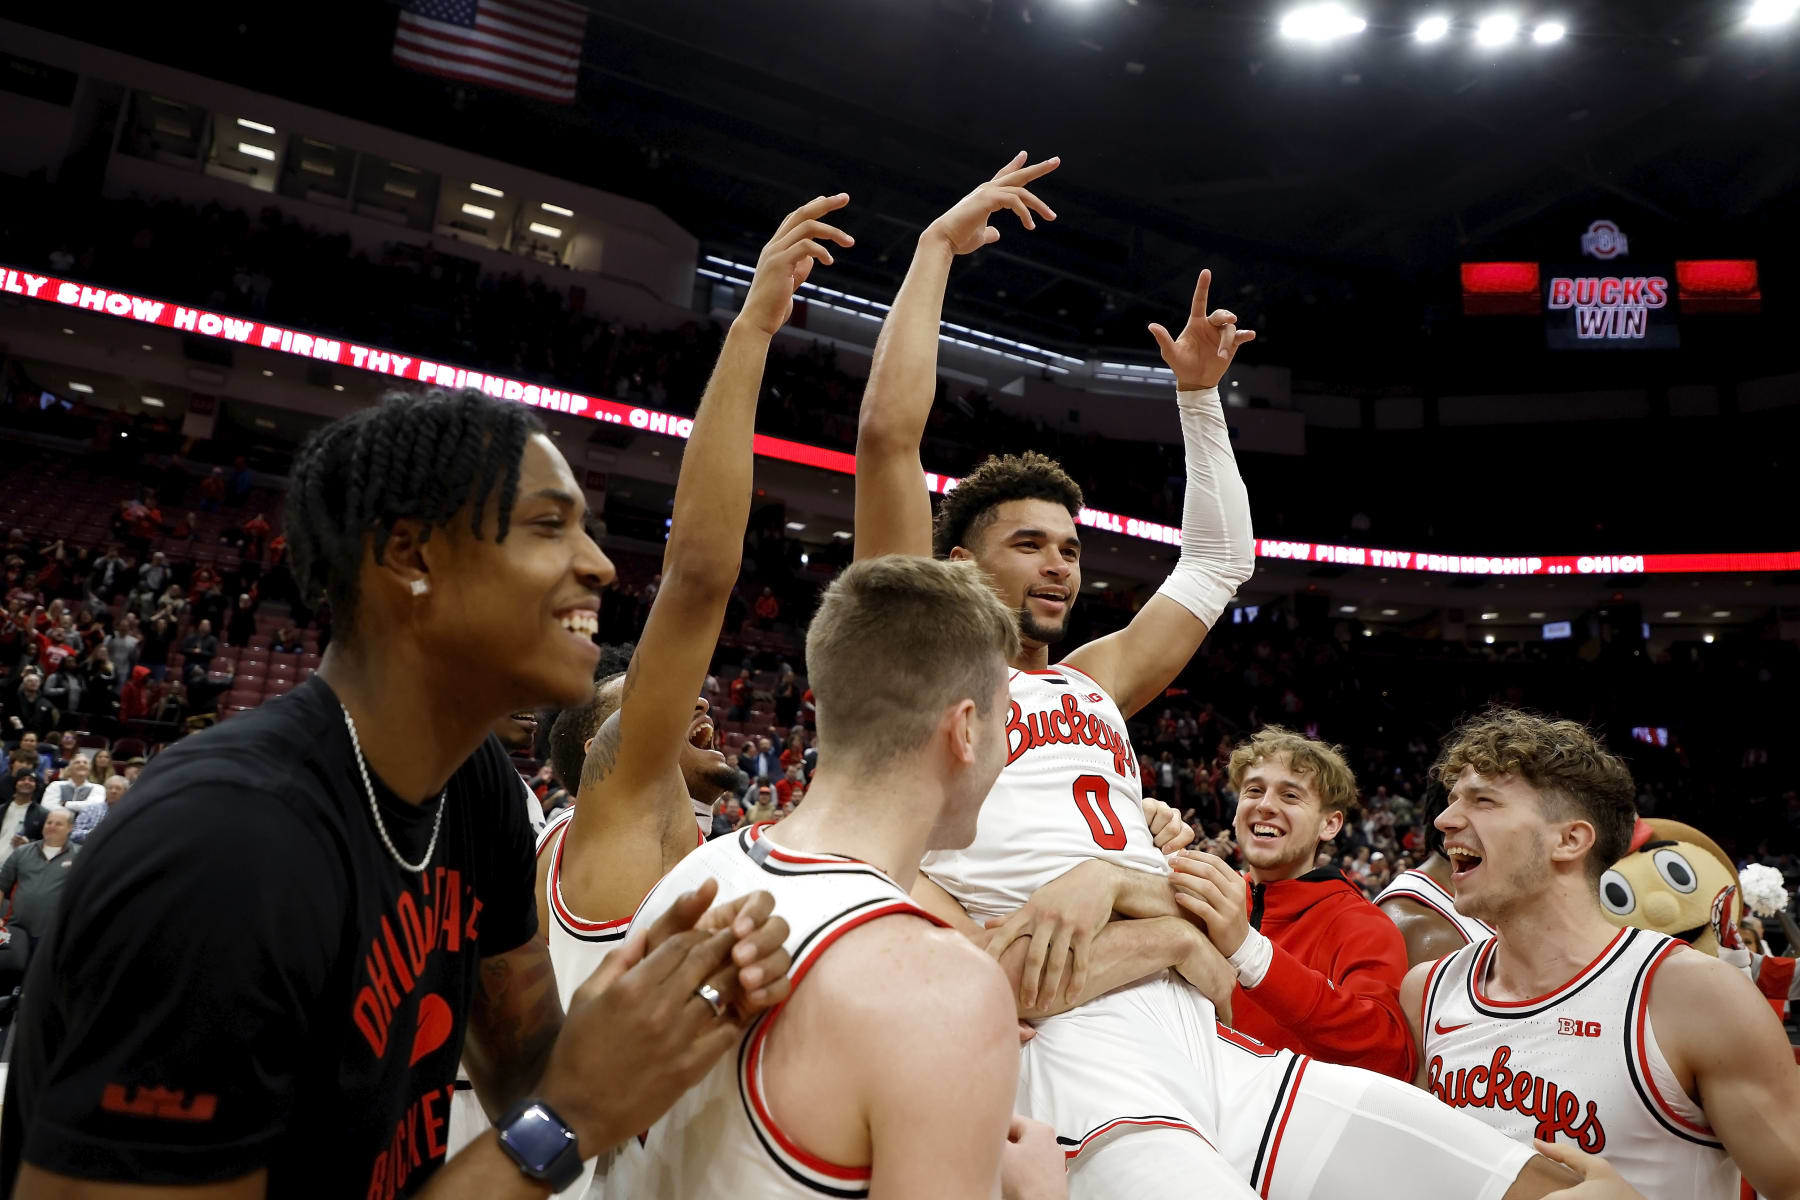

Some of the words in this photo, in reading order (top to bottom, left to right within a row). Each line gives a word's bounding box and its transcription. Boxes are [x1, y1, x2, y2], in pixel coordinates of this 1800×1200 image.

[1549, 276, 1668, 309] BUCKS
[1576, 306, 1648, 339] WIN
[57, 282, 164, 323] SHOW
[173, 306, 254, 342] HOW
[261, 326, 341, 362] FIRM
[350, 345, 411, 377] THY
[418, 361, 588, 415] FRIENDSHIP
[1079, 507, 1123, 533] WILL
[1261, 540, 1310, 560] HOW
[1316, 545, 1366, 565] FIRM
[1371, 549, 1411, 569] THY
[1416, 553, 1542, 574] FRIENDSHIP
[1073, 774, 1128, 851] 0
